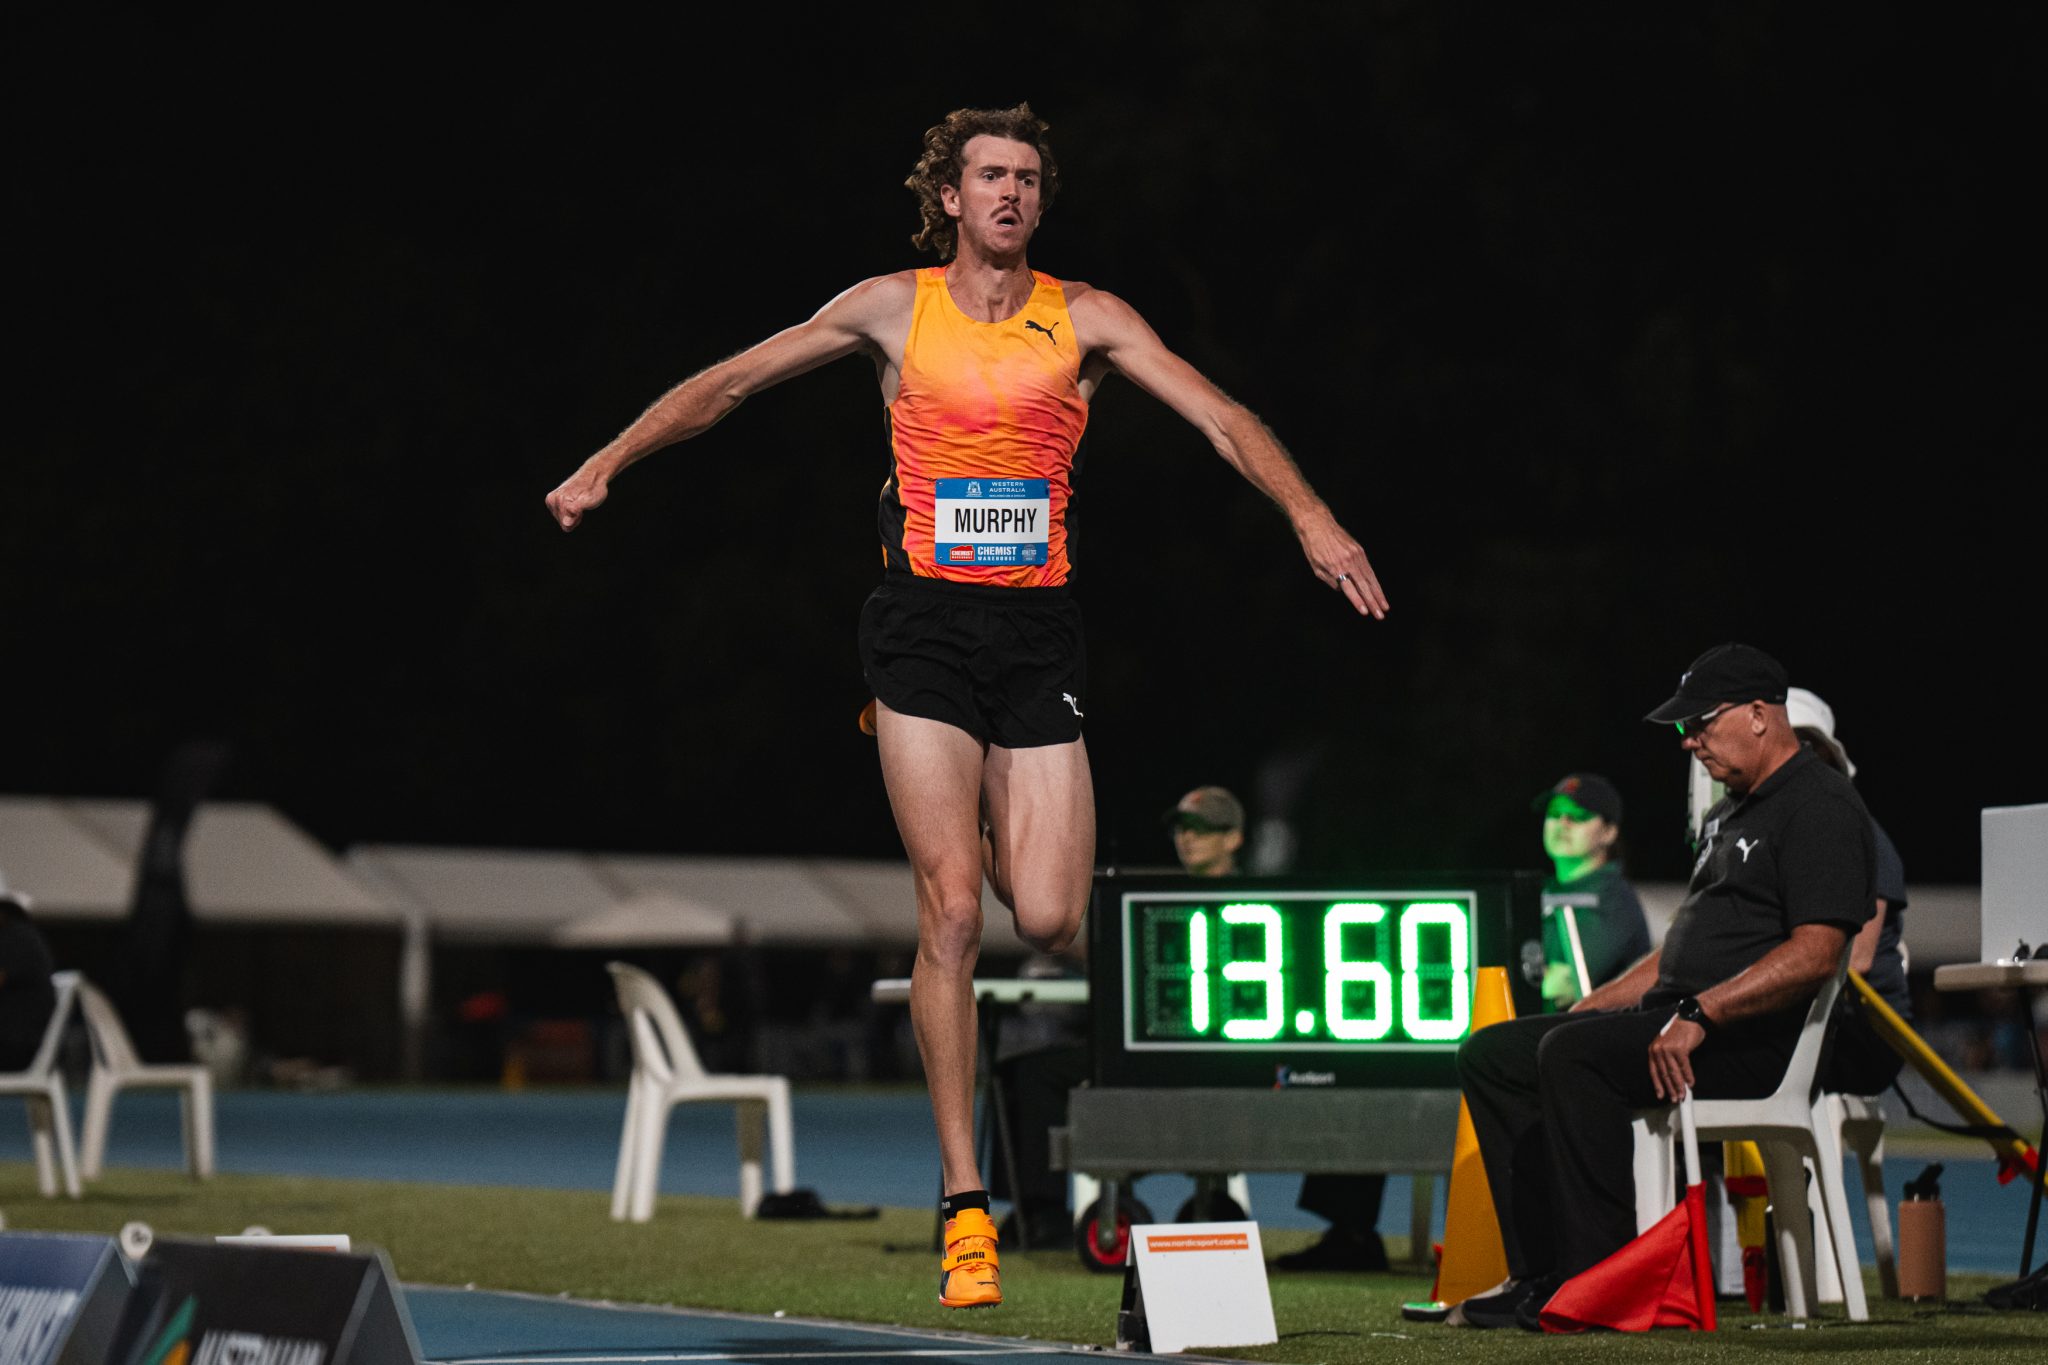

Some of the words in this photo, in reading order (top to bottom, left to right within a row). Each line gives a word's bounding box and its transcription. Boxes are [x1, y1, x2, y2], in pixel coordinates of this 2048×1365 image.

[955, 508, 1037, 533] MURPHY
[977, 546, 1017, 555] CHEMIST
[1190, 903, 1470, 1040] 13.60
[1150, 1238, 1248, 1249] www.nordicsport.com.au
[957, 1252, 985, 1263] PUMA
